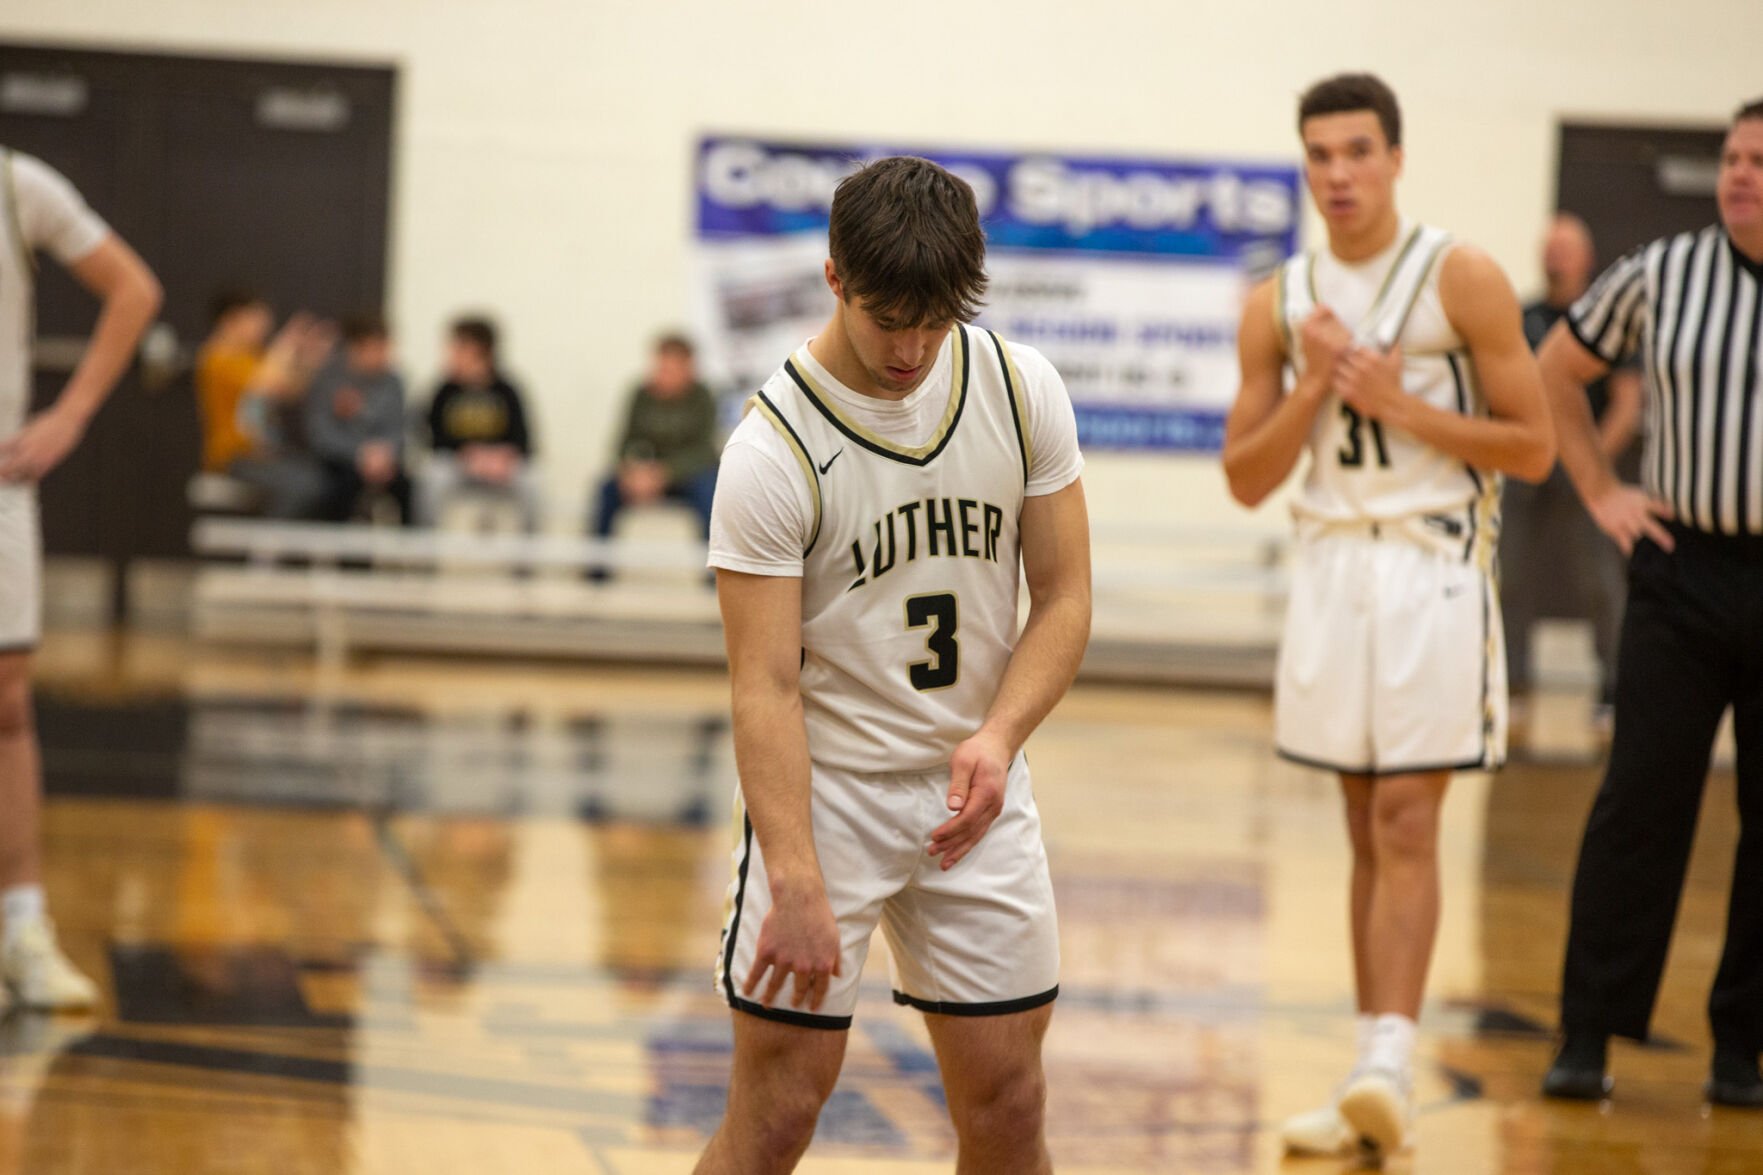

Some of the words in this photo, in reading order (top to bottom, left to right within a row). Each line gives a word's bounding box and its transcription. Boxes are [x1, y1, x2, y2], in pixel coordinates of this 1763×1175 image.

[1009, 158, 1292, 237] Sports
[1337, 400, 1391, 468] 31
[846, 497, 1003, 593] LUTHER
[904, 589, 960, 695] 3
